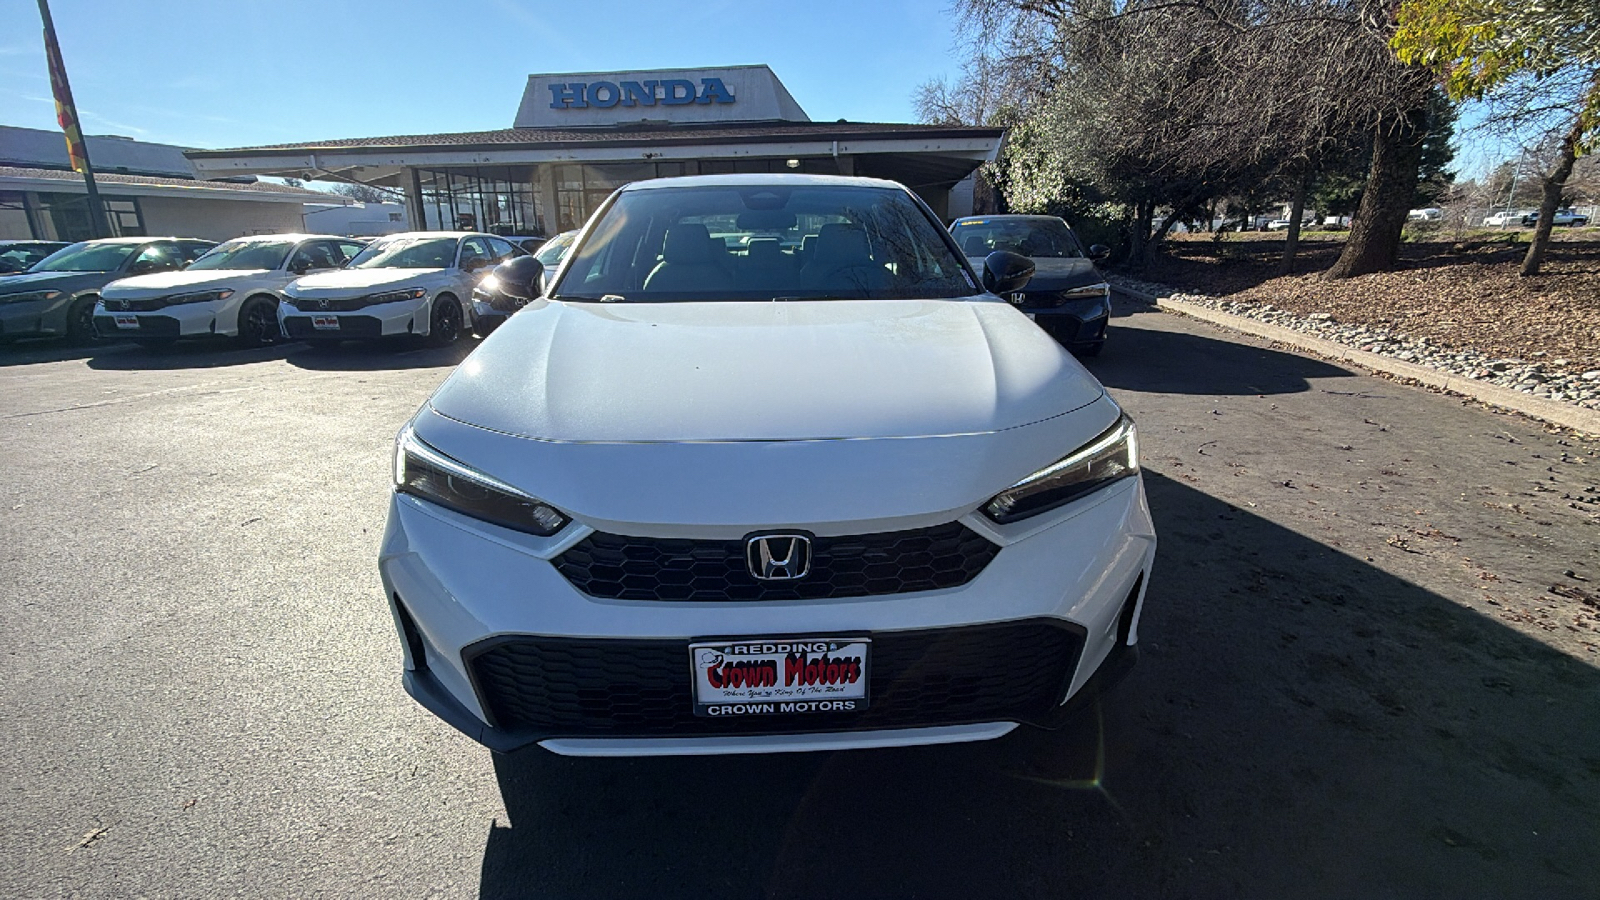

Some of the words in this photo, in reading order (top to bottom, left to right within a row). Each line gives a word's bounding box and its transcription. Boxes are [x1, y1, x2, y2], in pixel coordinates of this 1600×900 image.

[548, 77, 735, 109] HONDA
[734, 642, 828, 655] REDDING
[707, 655, 778, 688] Crown
[785, 653, 861, 687] Motors
[775, 689, 794, 697] King
[796, 687, 806, 696] Of
[808, 686, 823, 694] The
[825, 685, 845, 693] Road
[707, 703, 775, 716] CROWN
[779, 701, 856, 713] MOTORS
